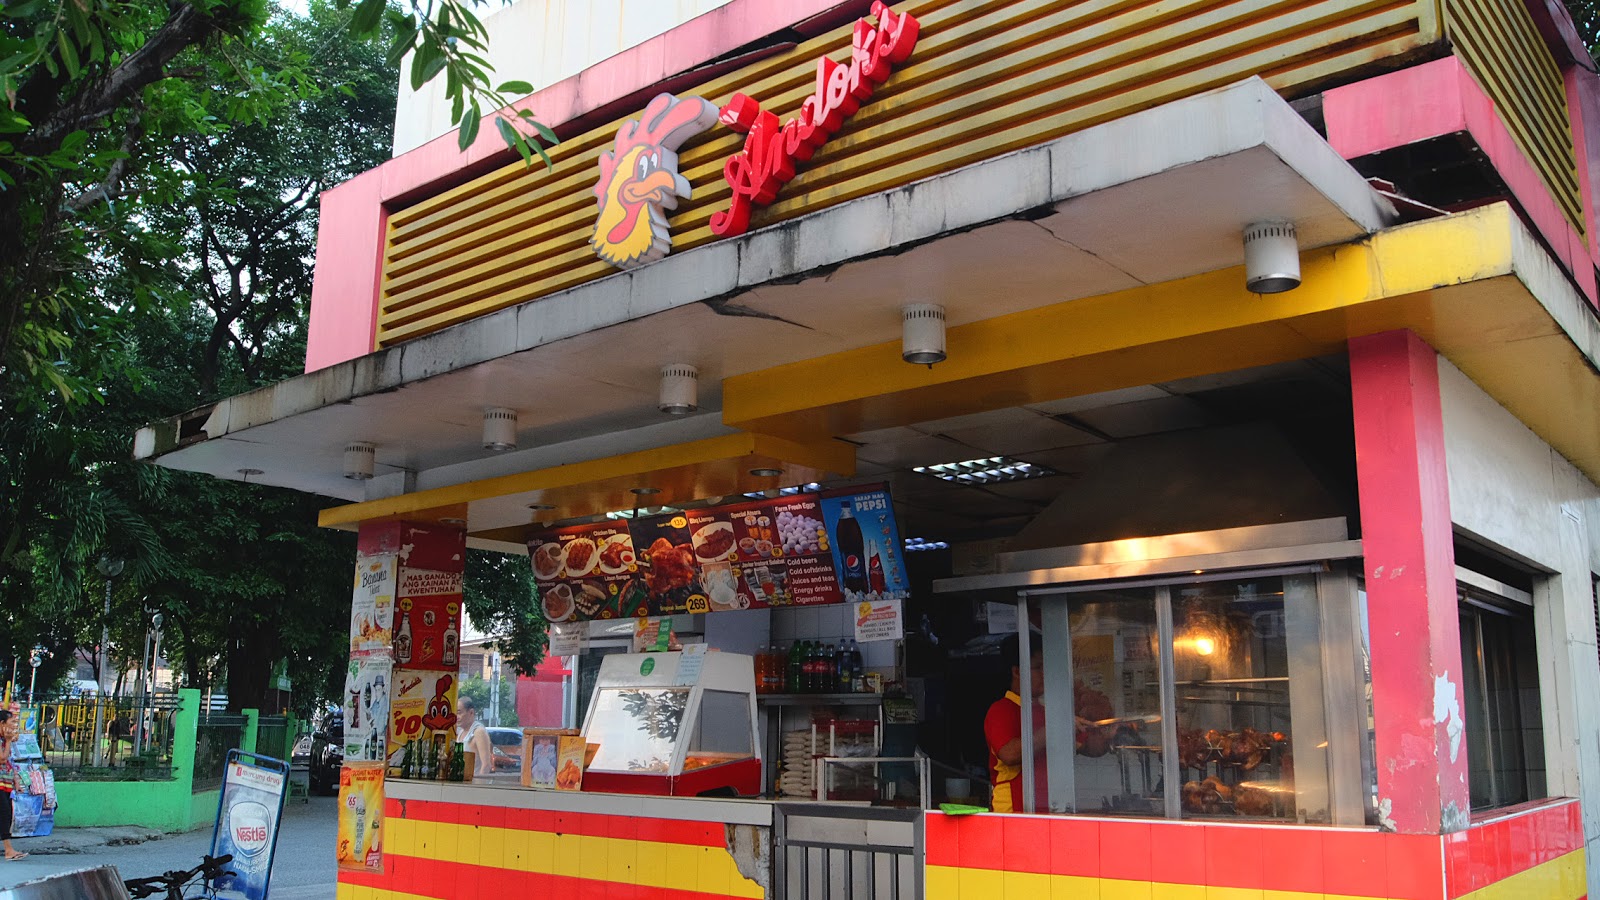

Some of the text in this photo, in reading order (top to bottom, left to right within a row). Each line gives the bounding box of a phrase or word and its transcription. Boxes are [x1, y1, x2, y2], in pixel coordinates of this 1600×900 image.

[709, 0, 921, 238] Andok's
[788, 503, 802, 511] Fresh
[803, 502, 816, 510] Eggs
[855, 499, 887, 512] PEPSI
[787, 558, 800, 566] Cold
[402, 580, 419, 588] ANG
[421, 579, 449, 587] KAINAN
[408, 586, 455, 595] KWENTUHAN
[794, 587, 814, 595] Energy
[688, 598, 706, 610] 269
[796, 595, 824, 604] Cigarettes
